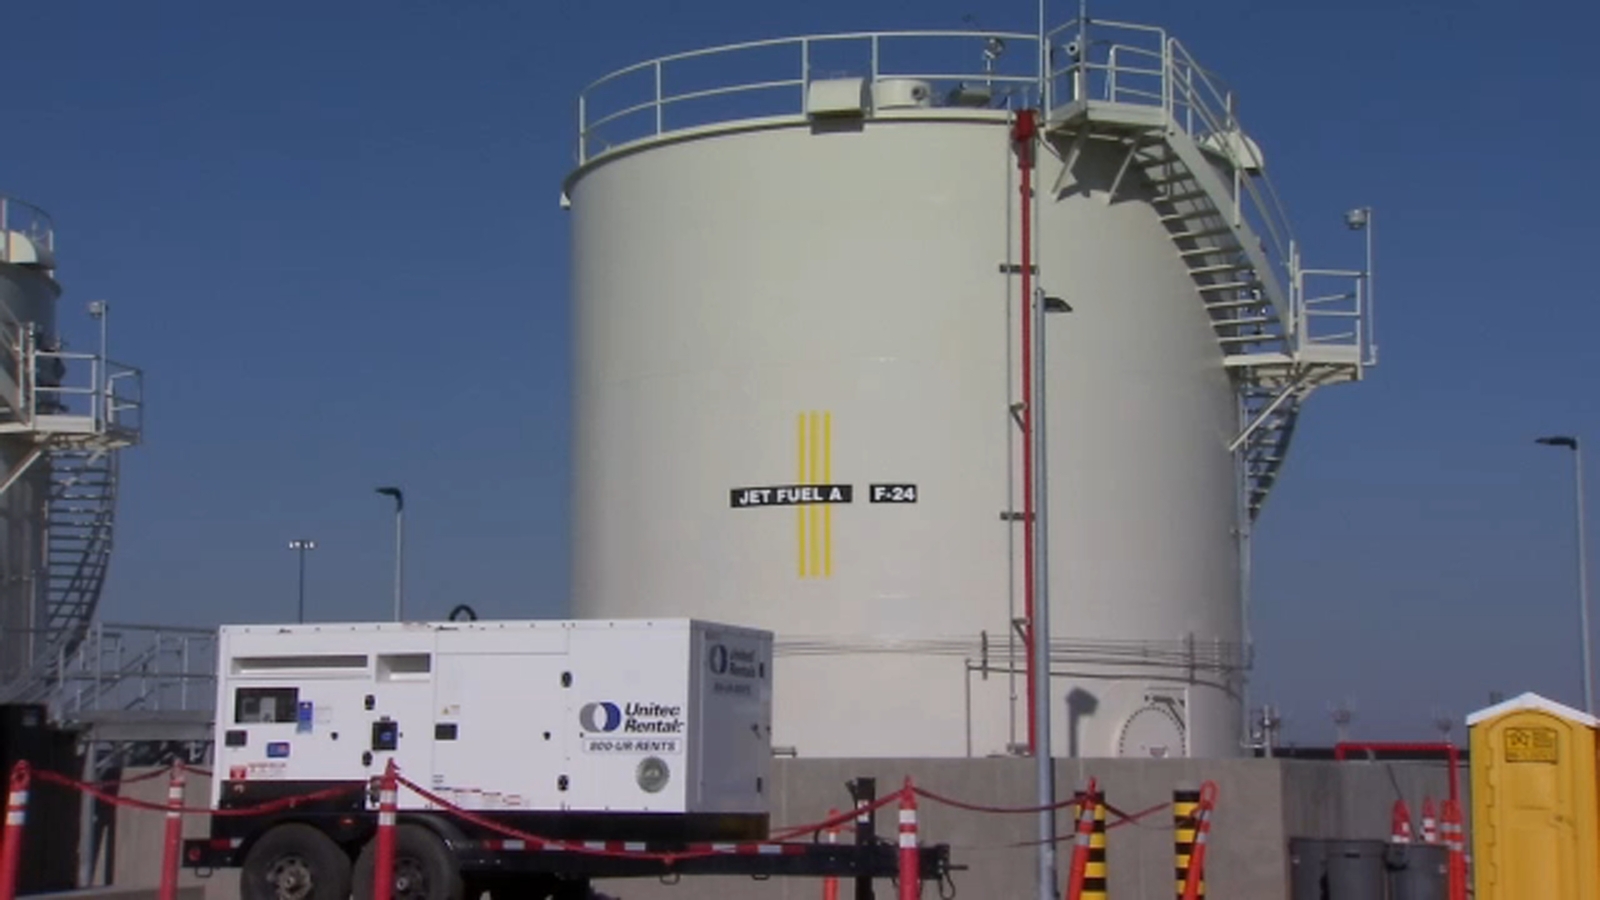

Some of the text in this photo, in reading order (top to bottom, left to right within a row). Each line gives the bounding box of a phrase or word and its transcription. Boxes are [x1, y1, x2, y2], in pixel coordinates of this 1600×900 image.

[739, 487, 842, 504] JET FUEL A
[875, 487, 915, 501] F-24
